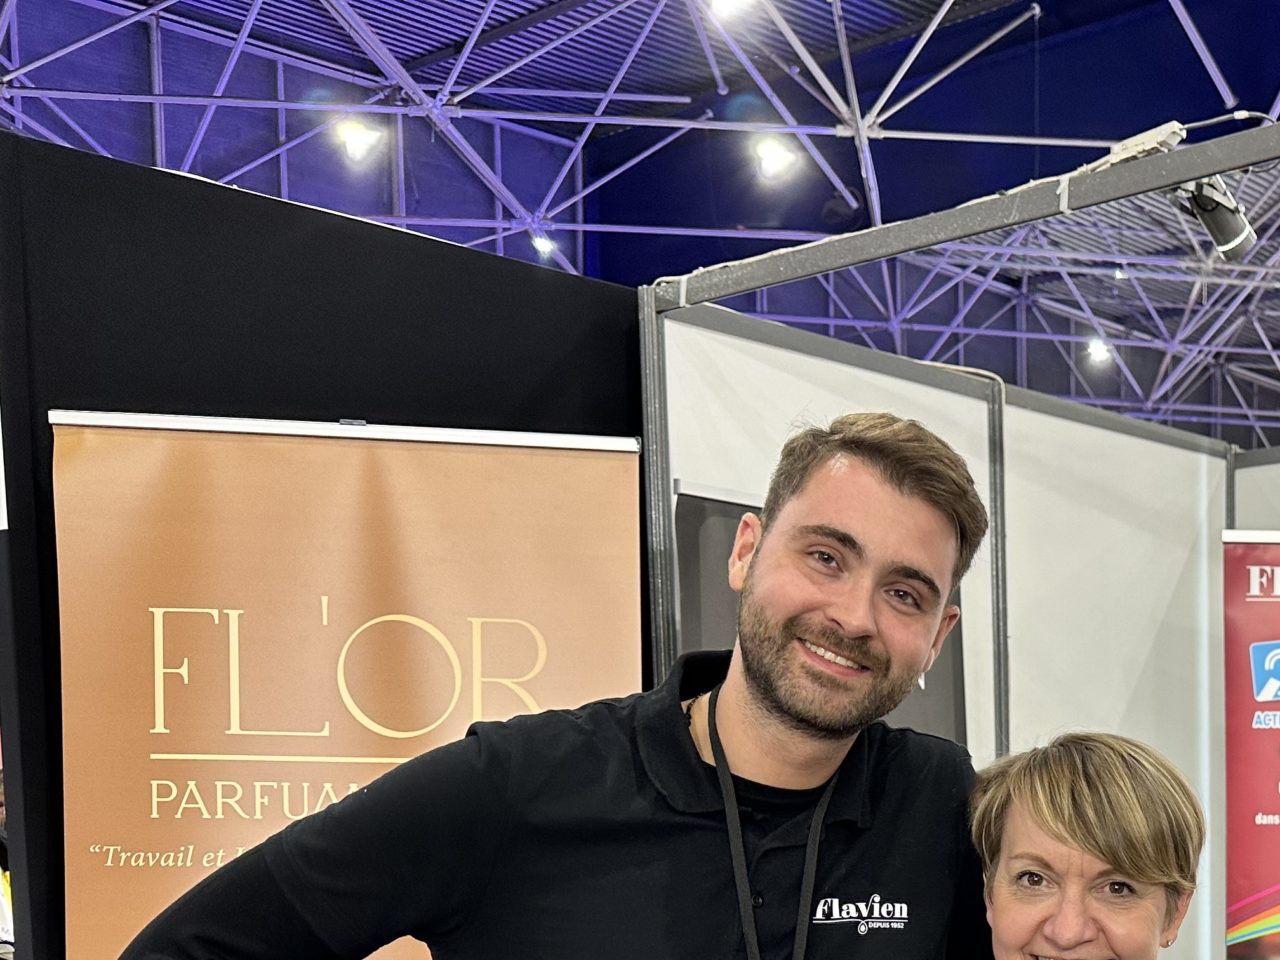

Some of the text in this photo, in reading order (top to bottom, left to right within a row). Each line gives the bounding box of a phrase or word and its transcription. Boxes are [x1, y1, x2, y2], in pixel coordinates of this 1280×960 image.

[149, 596, 548, 738] FL'OR
[1255, 812, 1280, 825] dans
[202, 846, 227, 868] et
[813, 894, 908, 920] Flavien
